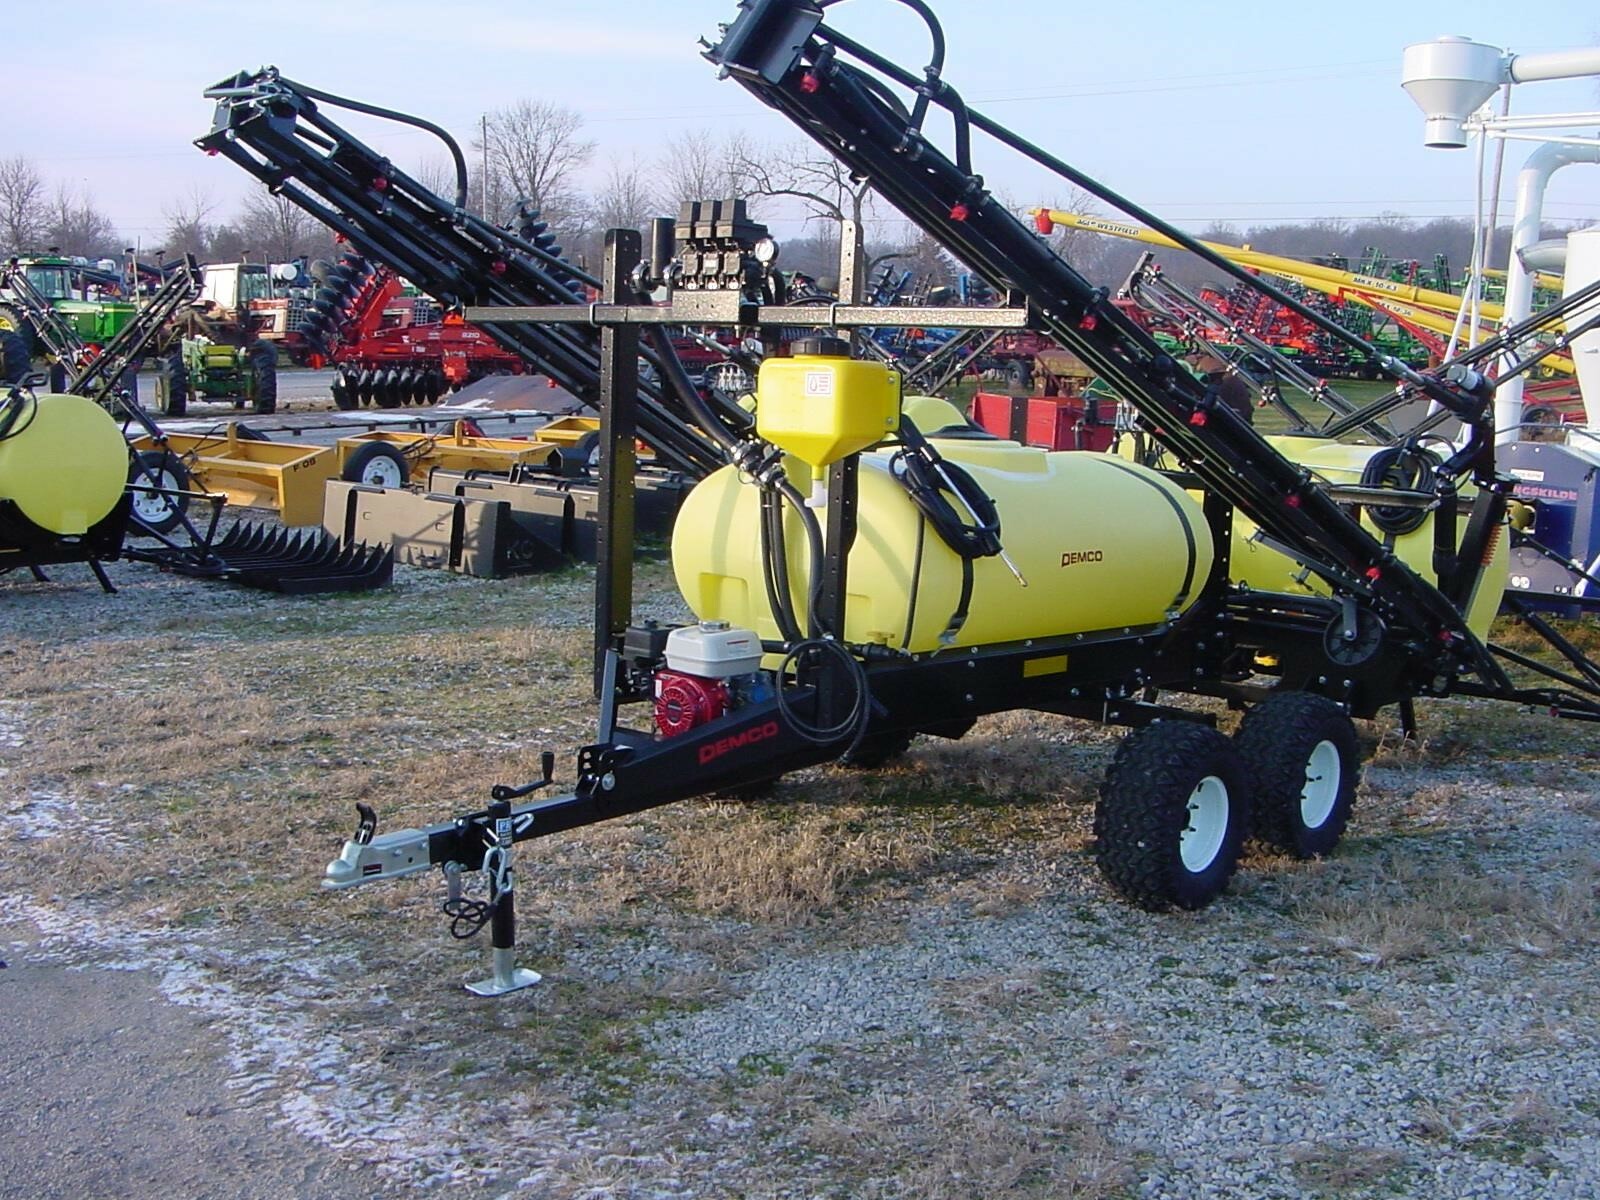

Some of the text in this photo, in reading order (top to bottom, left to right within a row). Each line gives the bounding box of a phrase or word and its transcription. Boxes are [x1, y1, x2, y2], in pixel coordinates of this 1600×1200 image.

[1513, 485, 1577, 500] NGSKILDE
[1061, 550, 1103, 567] DEMCO
[699, 721, 778, 765] DEMCO
